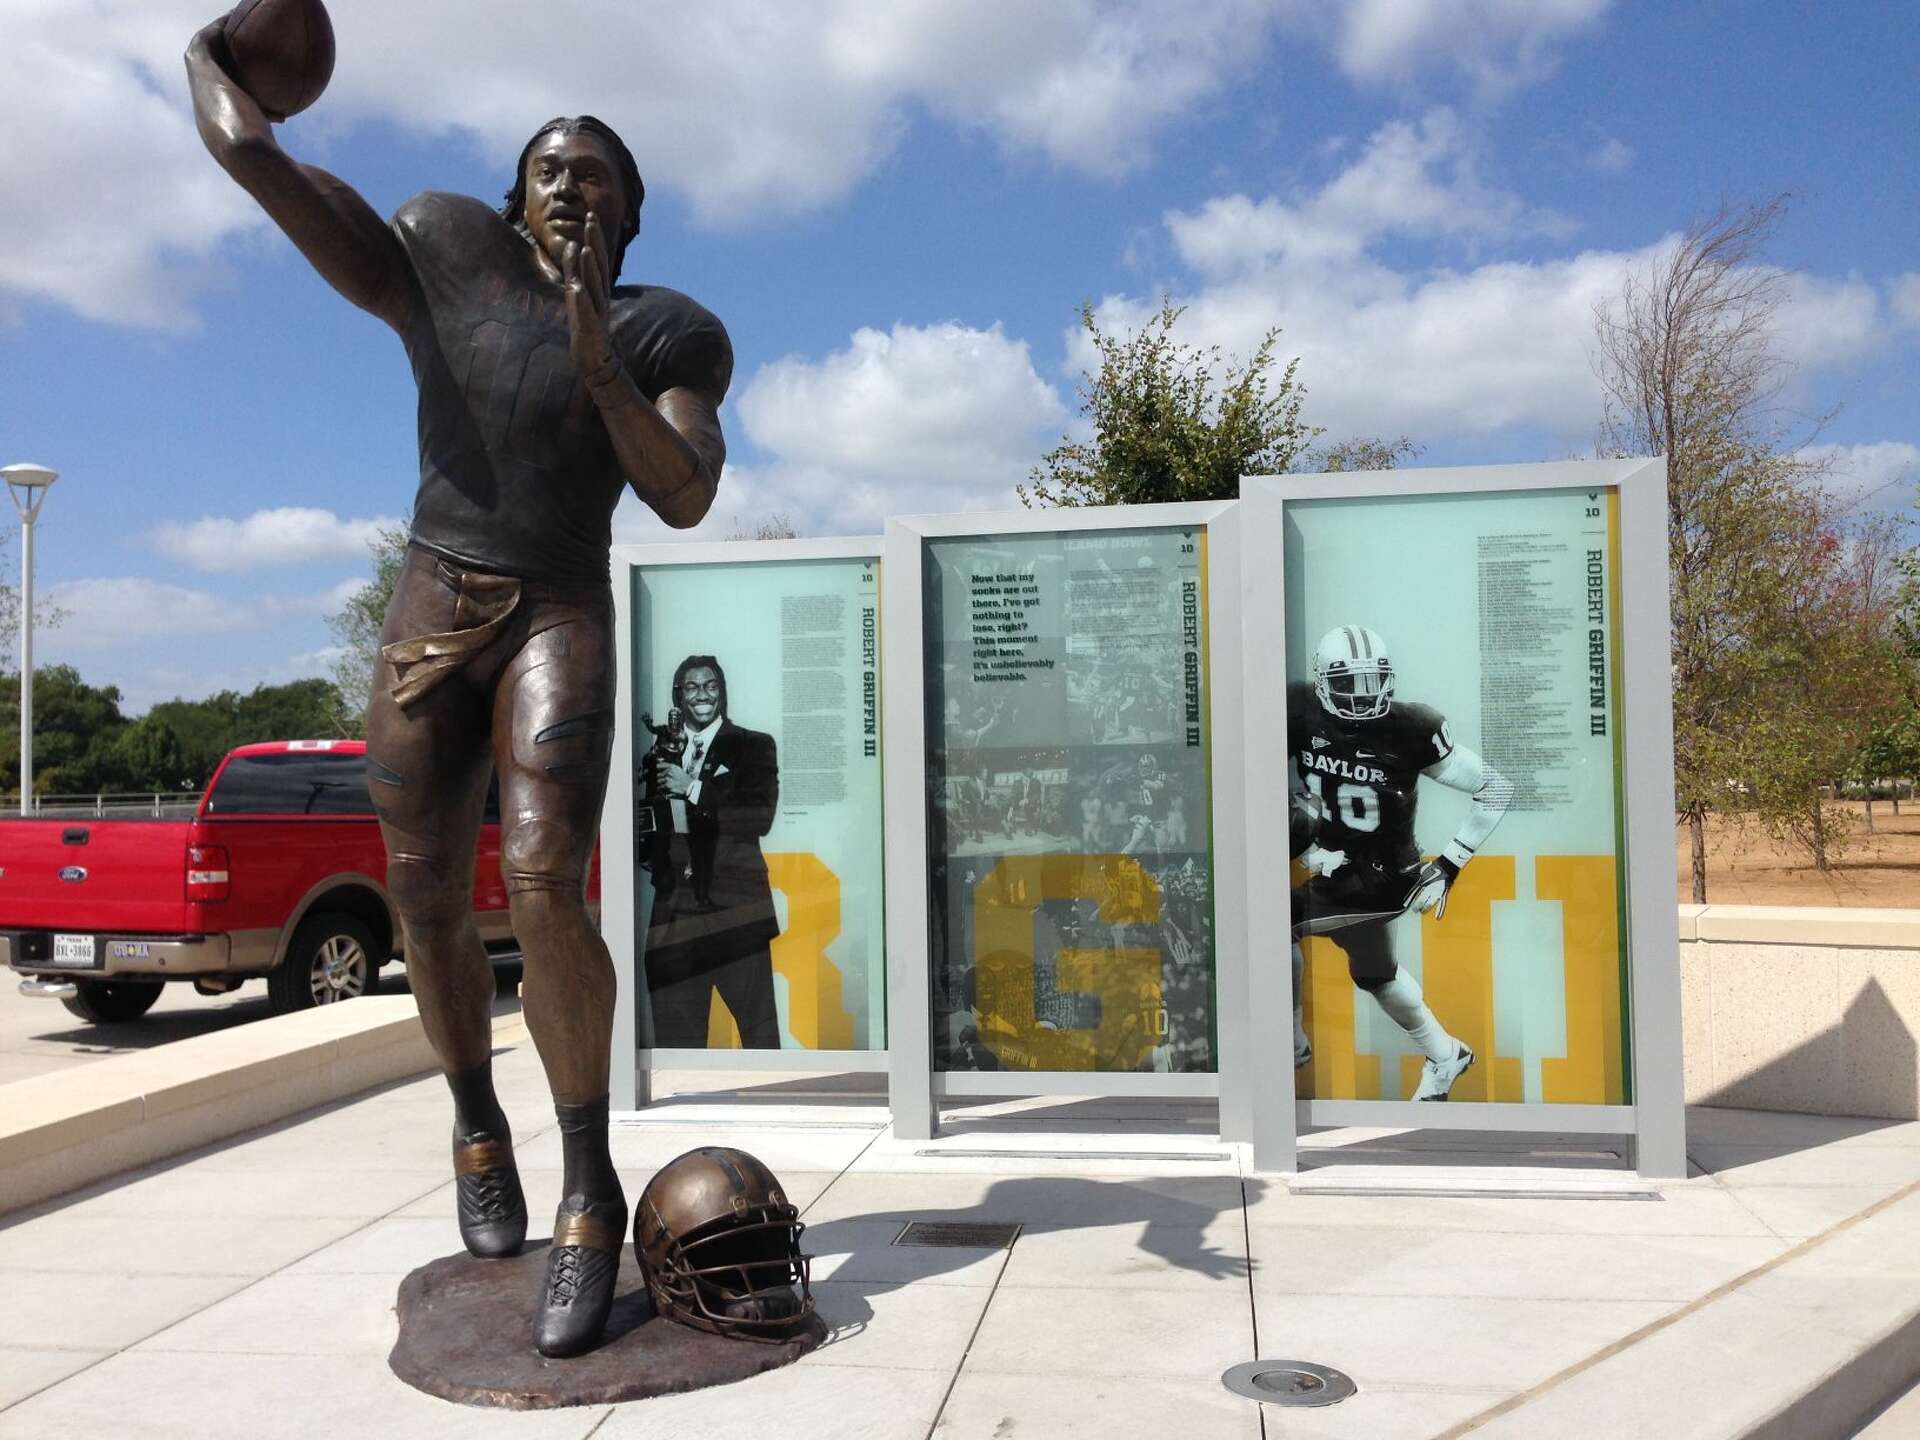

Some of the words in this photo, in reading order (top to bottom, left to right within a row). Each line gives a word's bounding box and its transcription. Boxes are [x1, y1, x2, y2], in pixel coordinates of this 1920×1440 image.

[1585, 507, 1600, 518] 10
[1181, 544, 1194, 553] 10
[861, 574, 873, 583] 10
[971, 574, 994, 583] Now
[996, 574, 1016, 582] that
[1019, 574, 1034, 582] my
[971, 587, 1001, 595] socks
[1586, 549, 1603, 624] ROBERT
[972, 599, 1001, 608] there,
[1003, 598, 1021, 606] I've
[1023, 598, 1040, 608] got
[972, 611, 1011, 621] nothing
[1013, 611, 1024, 619] to
[1182, 581, 1198, 648] ROBERT
[972, 624, 996, 632] lose,
[997, 622, 1028, 633] right?
[862, 607, 875, 668] ROBERT
[972, 636, 996, 645] This
[997, 635, 1039, 644] moment
[973, 649, 997, 658] right
[990, 658, 1055, 670] unbelievably
[1588, 629, 1605, 709] GRIFFIN
[973, 672, 1027, 682] believable.
[1184, 651, 1199, 723] GRIFFIN
[863, 671, 876, 735] GRIFFIN
[1590, 714, 1606, 737] III
[1186, 727, 1200, 747] III
[1432, 720, 1454, 759] 10
[864, 739, 876, 757] III
[1301, 750, 1388, 786] BAYLOR
[1305, 773, 1381, 833] 10
